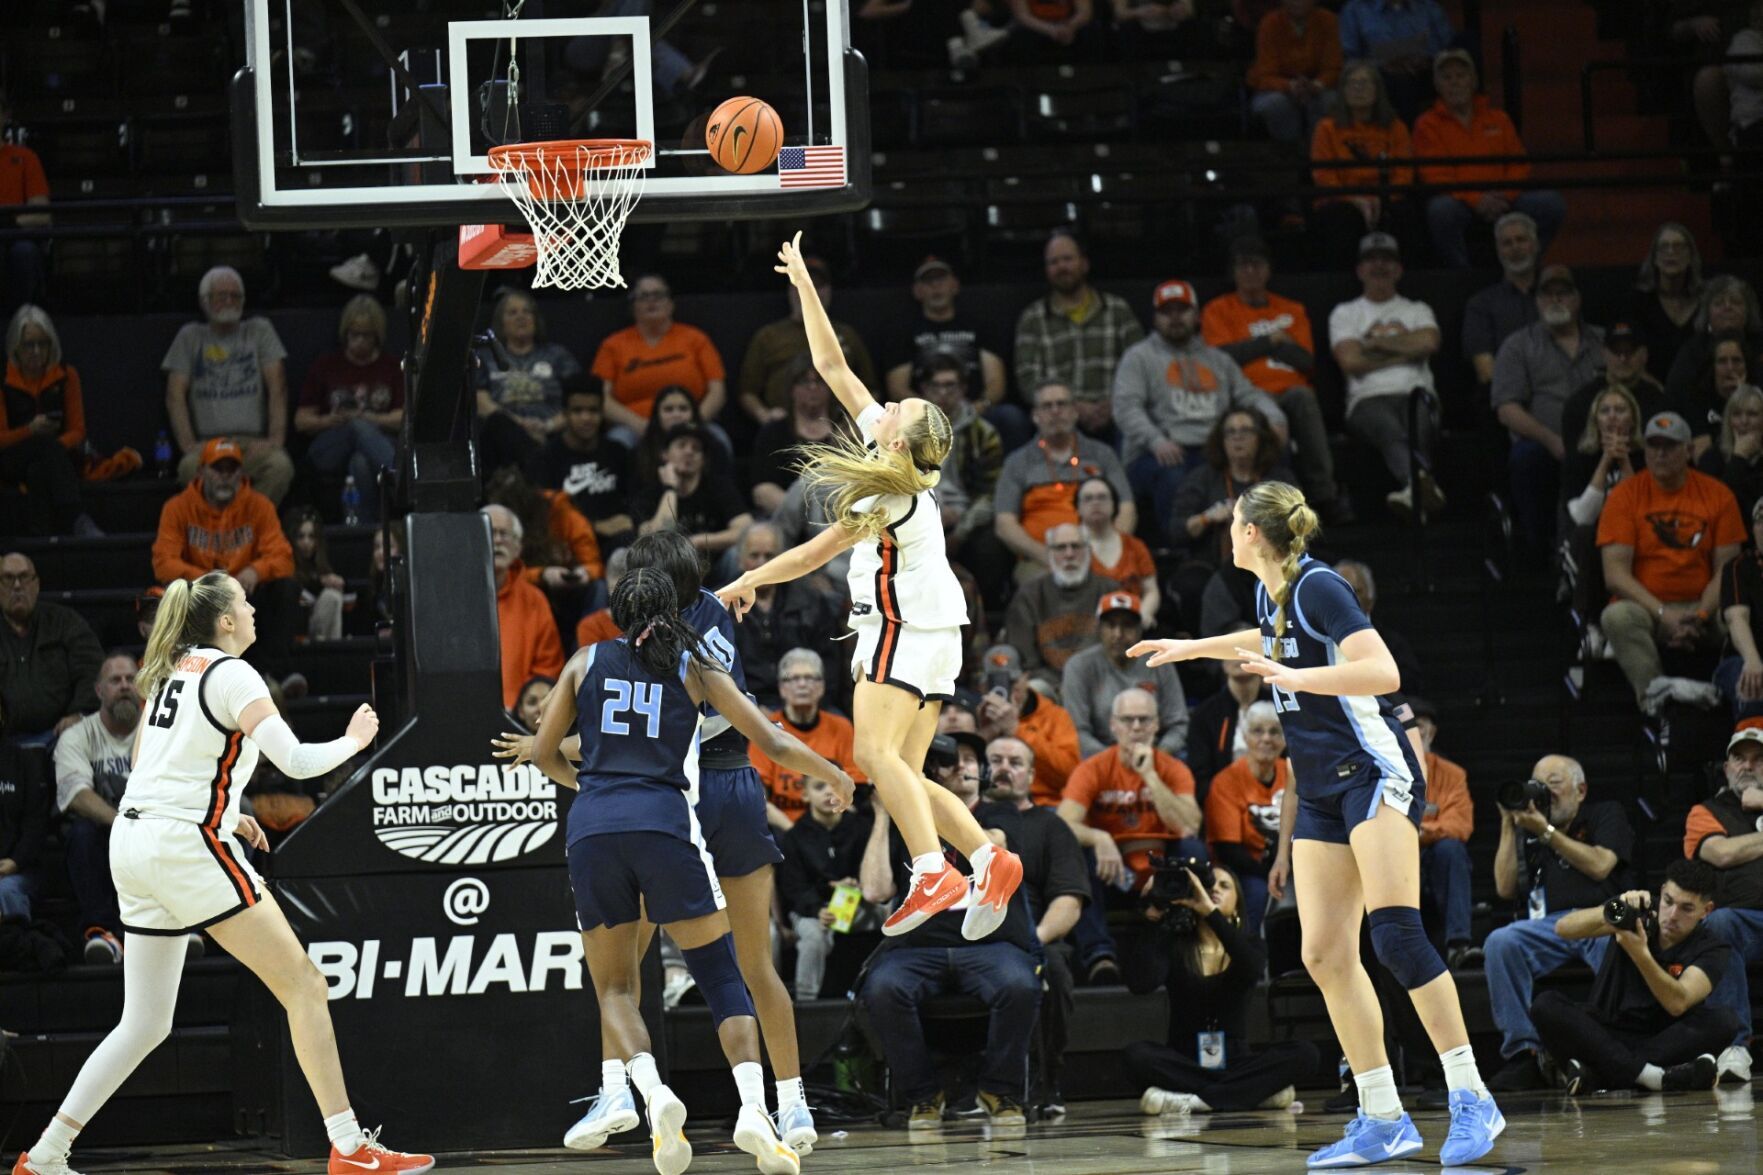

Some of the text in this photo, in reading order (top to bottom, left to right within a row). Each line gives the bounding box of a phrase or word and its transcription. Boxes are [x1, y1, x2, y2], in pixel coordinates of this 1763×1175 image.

[148, 677, 185, 729] 15
[600, 677, 663, 739] 24
[371, 763, 557, 806] CASCADE
[373, 801, 558, 826] FARM and OUTDOOR
[442, 876, 491, 926] @
[307, 930, 585, 1001] BI-MAR
